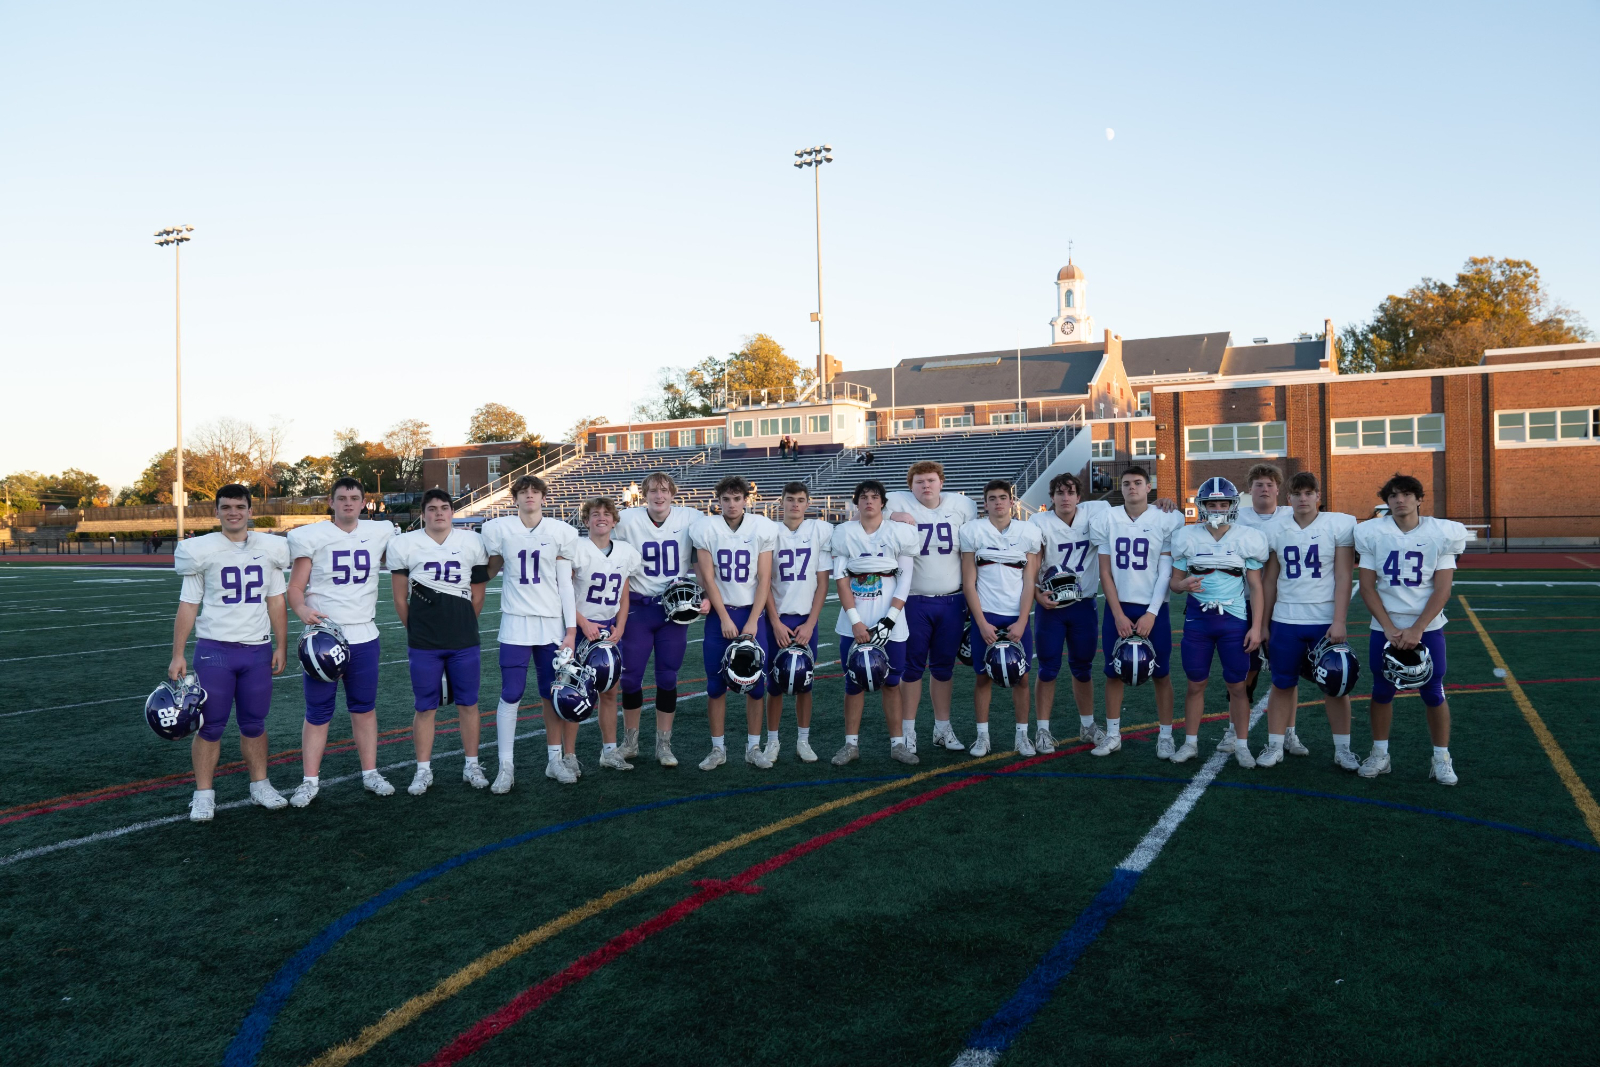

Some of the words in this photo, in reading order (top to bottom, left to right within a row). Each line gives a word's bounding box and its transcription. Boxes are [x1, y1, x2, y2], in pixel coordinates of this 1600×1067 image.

[918, 523, 953, 555] 79
[1058, 540, 1089, 572] 77
[1116, 537, 1150, 570] 89
[332, 550, 370, 585] 59
[518, 550, 540, 584] 11
[642, 540, 679, 577] 90
[717, 549, 750, 583] 88
[778, 548, 811, 581] 27
[1284, 544, 1322, 579] 84
[1383, 550, 1424, 586] 43
[221, 565, 263, 604] 92
[586, 572, 622, 605] 23
